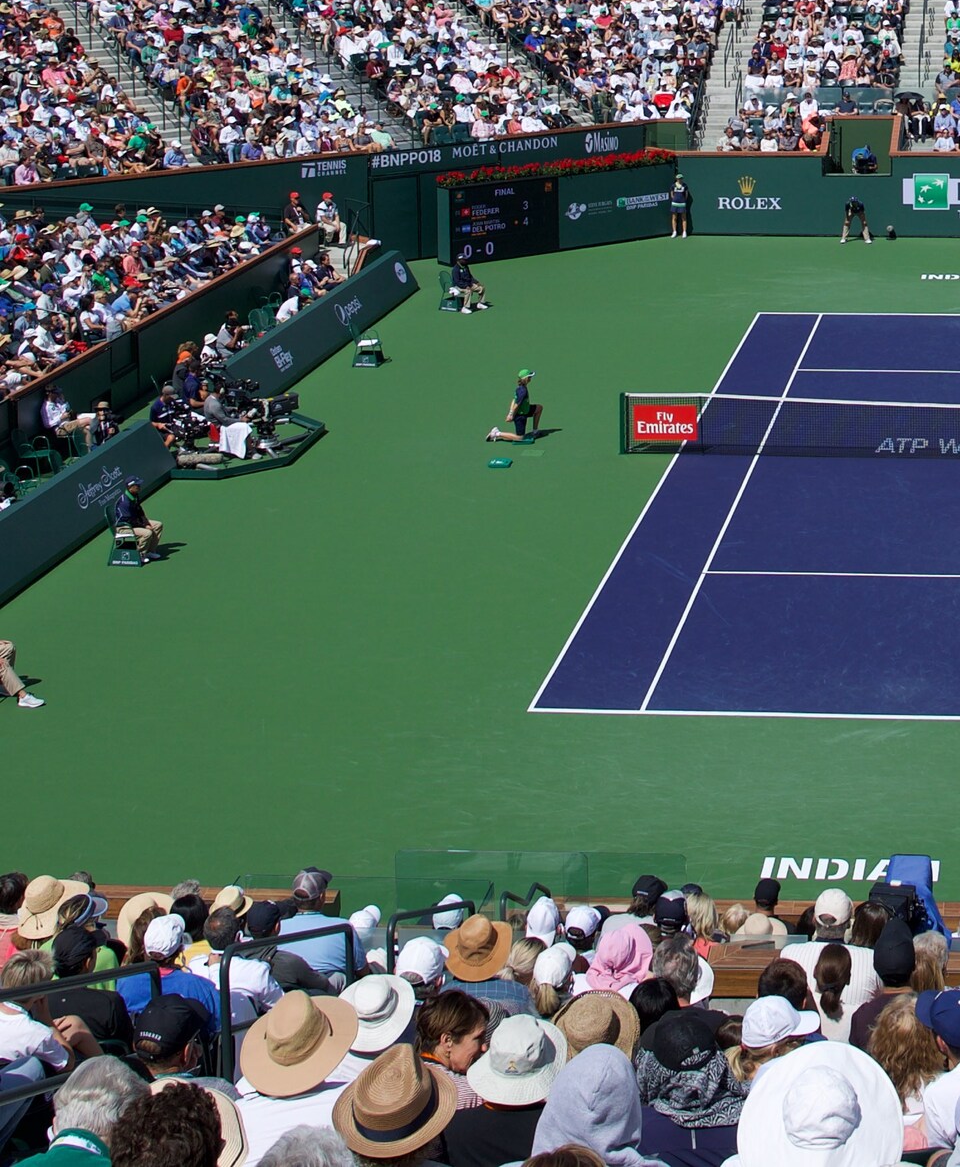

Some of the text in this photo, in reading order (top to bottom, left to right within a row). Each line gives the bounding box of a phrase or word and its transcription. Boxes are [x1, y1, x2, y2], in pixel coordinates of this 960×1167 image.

[490, 146, 497, 154] &
[499, 136, 558, 153] CHANDON
[317, 160, 347, 171] TENNIS
[371, 150, 441, 168] #BNPPO18
[317, 169, 346, 177] CHANNEL
[494, 188, 515, 197] FINAL
[718, 197, 782, 210] ROLEX
[472, 207, 500, 216] FEDERER
[485, 223, 506, 231] POTRO
[464, 244, 472, 259] 0
[486, 241, 494, 255] 0
[656, 411, 673, 422] Fly
[637, 421, 694, 434] Emirates
[875, 437, 929, 453] ATP
[760, 856, 940, 881] INDIA
